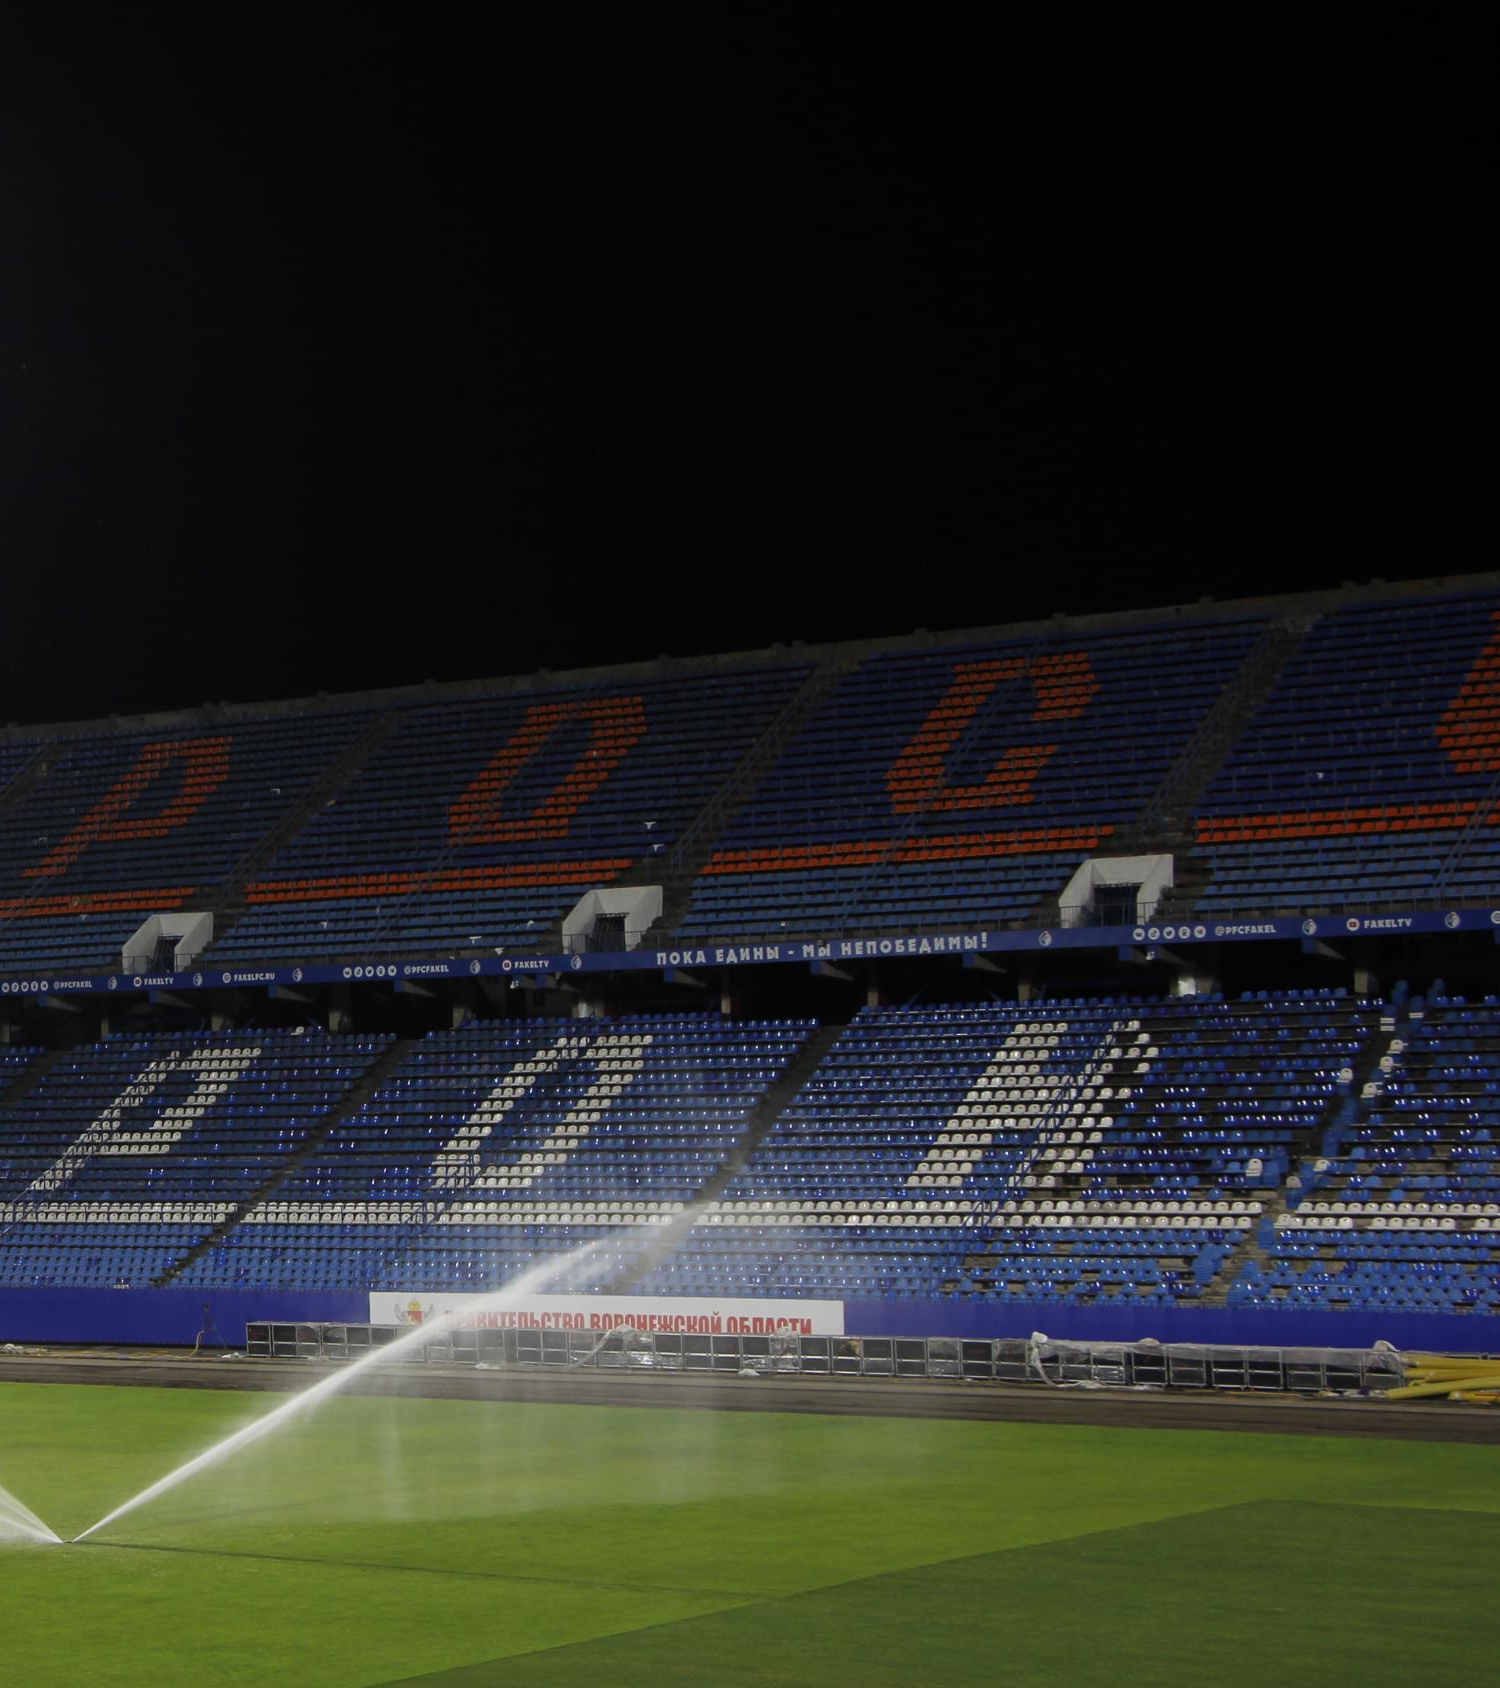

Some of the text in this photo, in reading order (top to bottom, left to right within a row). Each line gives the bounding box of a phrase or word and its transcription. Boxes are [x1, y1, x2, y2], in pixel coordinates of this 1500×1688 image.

[1363, 917, 1412, 929] FAKELTV
[1214, 924, 1276, 936] @PFCFAKEL
[656, 950, 707, 966] ПОКА
[715, 945, 780, 964] ЕДИНЫ
[802, 943, 831, 958] МЫ
[840, 931, 988, 955] НЕПОБЕДИМЫ!
[403, 964, 450, 975] @PFCFAKEL
[514, 959, 549, 969] FAKELTV
[143, 977, 174, 986] FAKELTV
[233, 972, 276, 981] FAKELFC.RU
[590, 1311, 722, 1333] ВОРОНЕЖСКОЙ
[726, 1315, 812, 1335] ОБЛАСТИ
